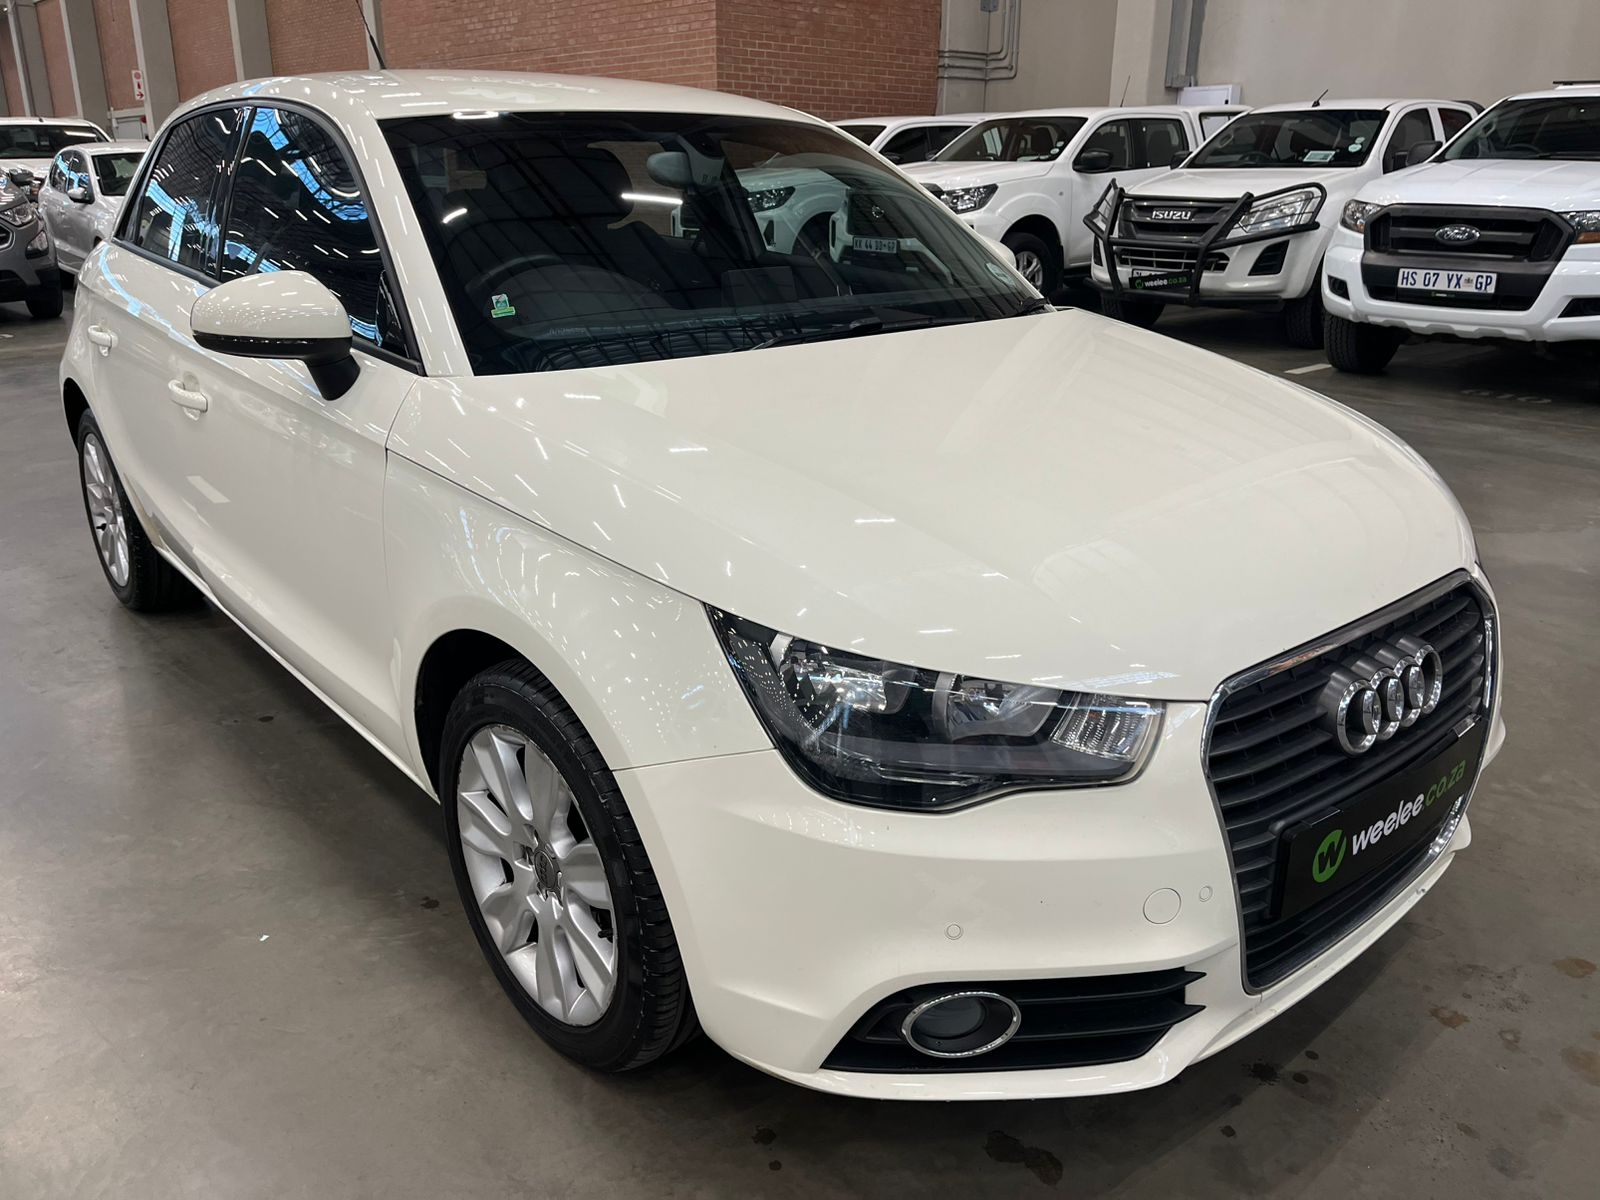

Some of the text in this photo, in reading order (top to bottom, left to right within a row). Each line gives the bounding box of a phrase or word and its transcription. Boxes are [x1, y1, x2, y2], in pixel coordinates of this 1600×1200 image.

[1152, 210, 1191, 220] ISUZU
[1443, 229, 1469, 240] Ford
[1401, 271, 1493, 291] HS 07 YX GP
